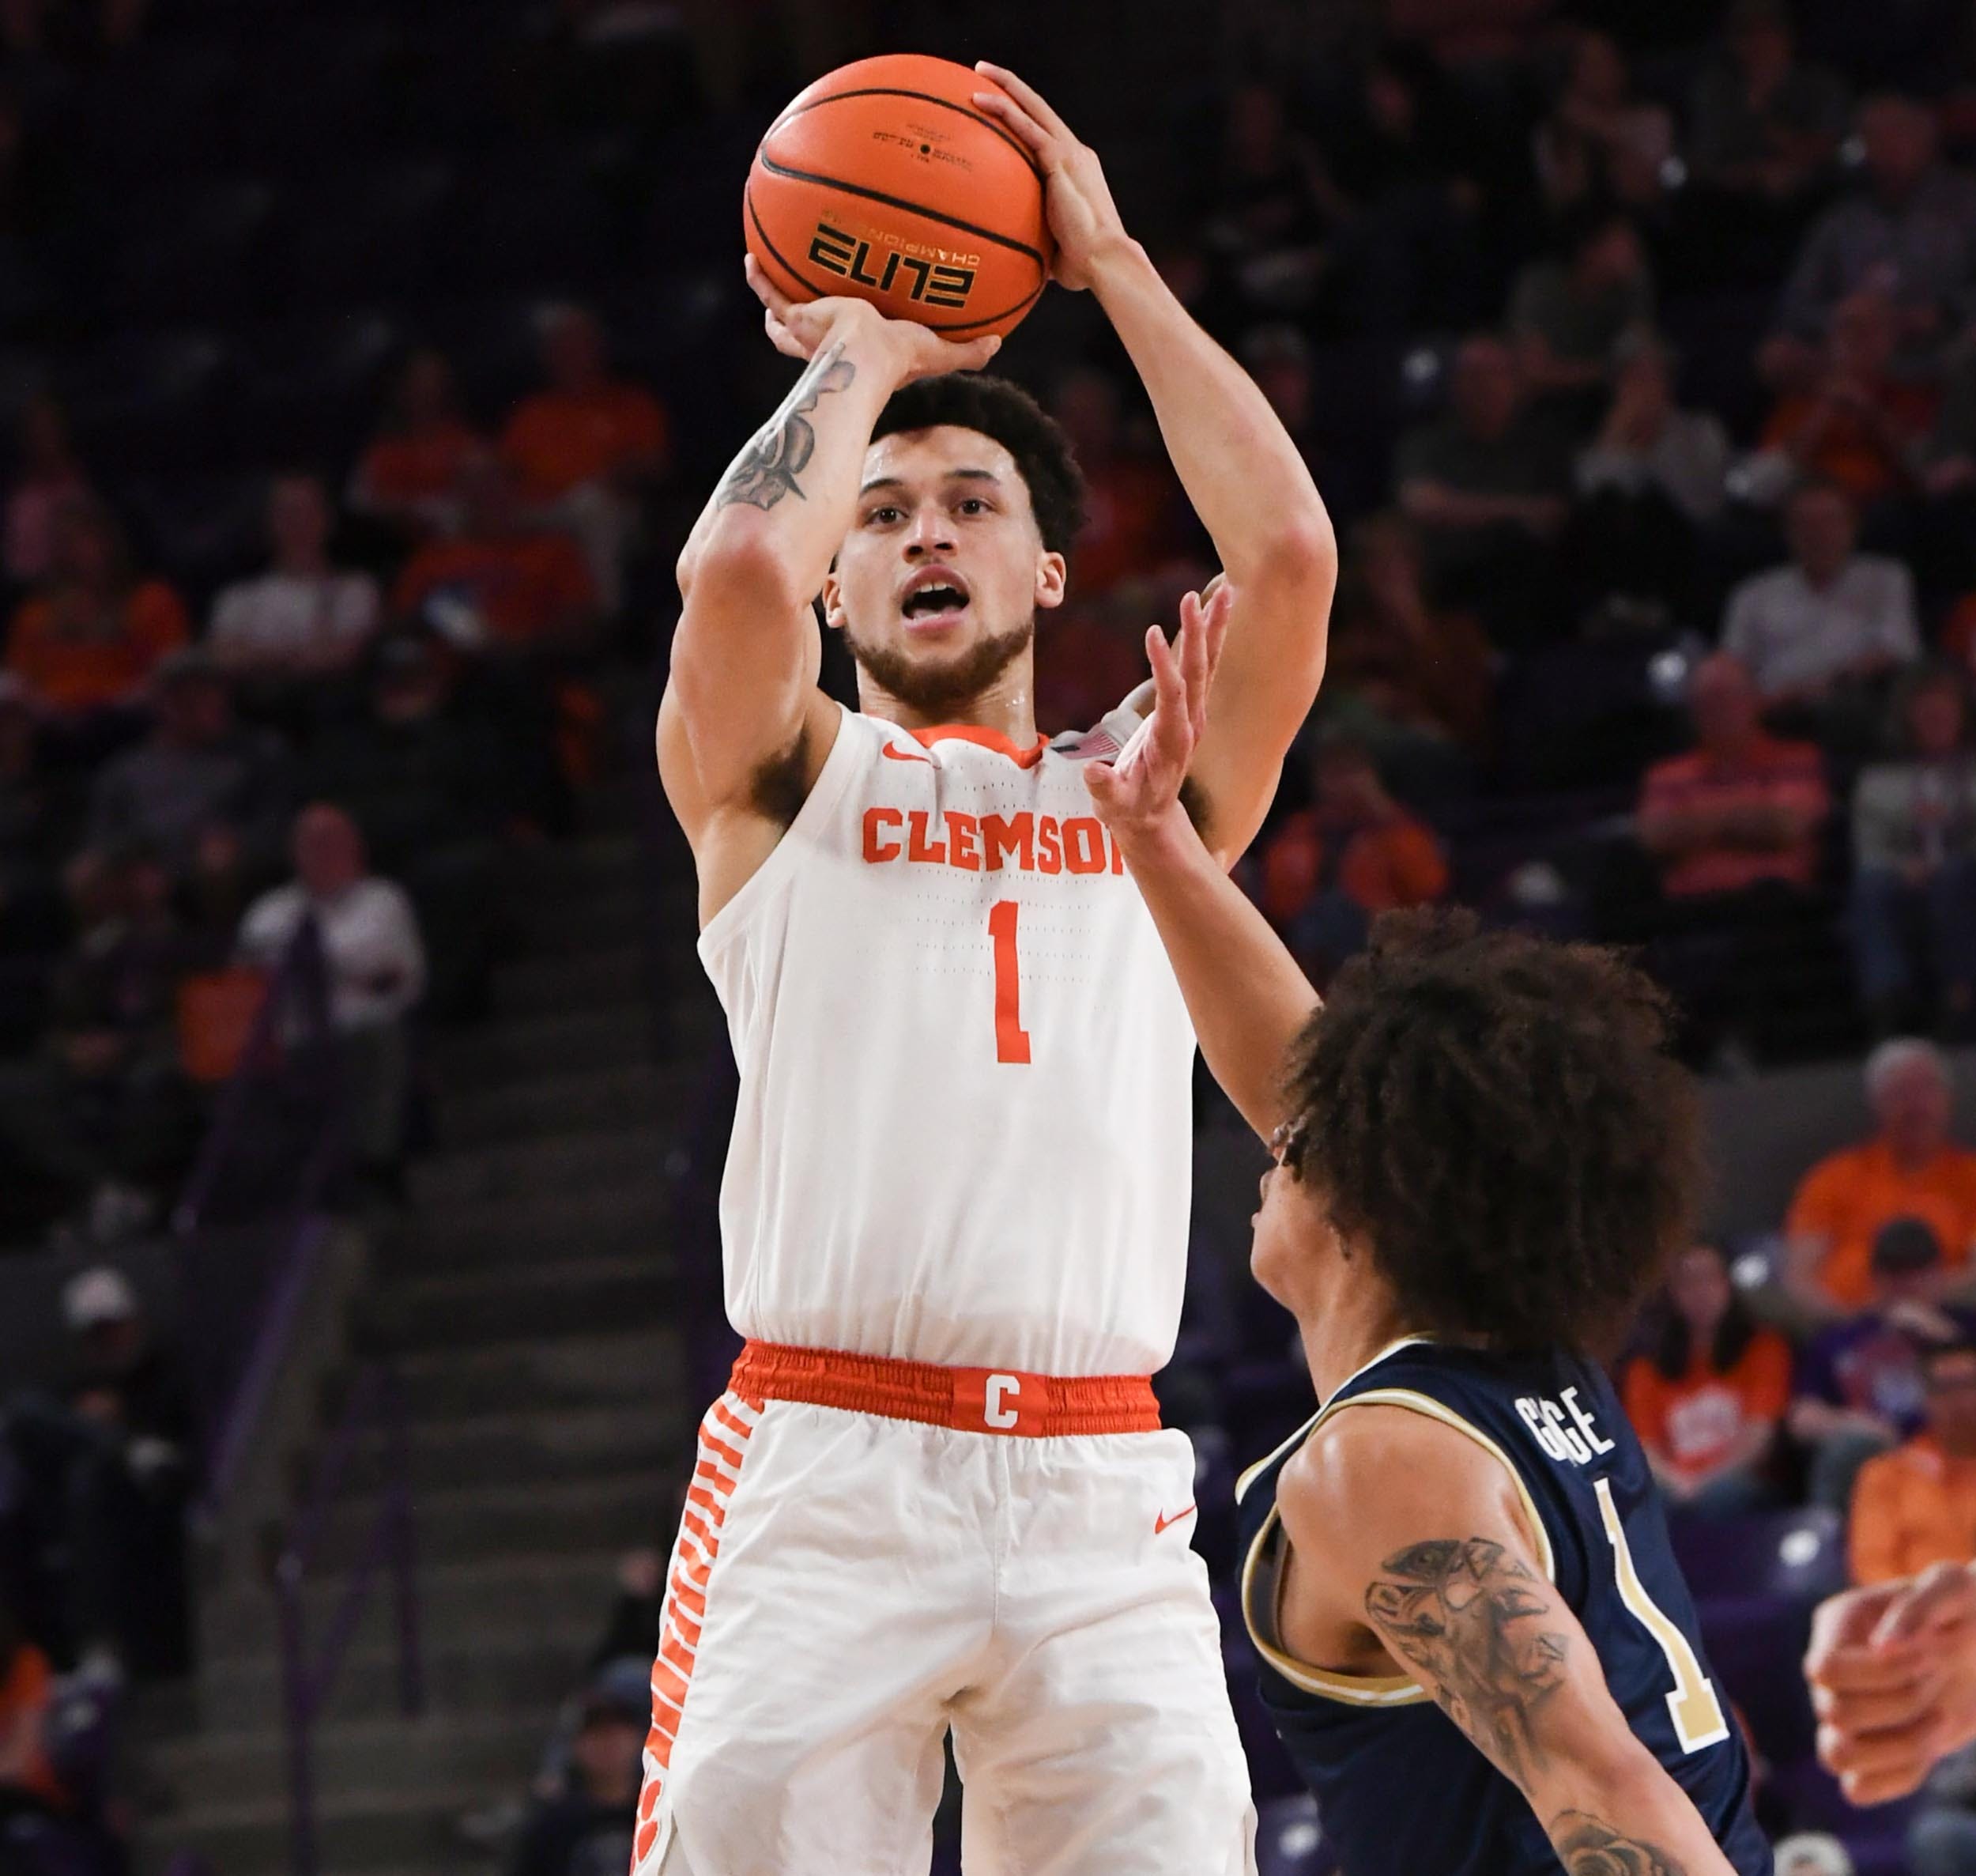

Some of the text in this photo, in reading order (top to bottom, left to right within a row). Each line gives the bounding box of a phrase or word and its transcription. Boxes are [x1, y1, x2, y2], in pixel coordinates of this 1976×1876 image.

[808, 224, 976, 308] ELITE
[988, 900, 1031, 1064] 1
[983, 1373, 1020, 1429] C
[1593, 1477, 1731, 1754] 1
